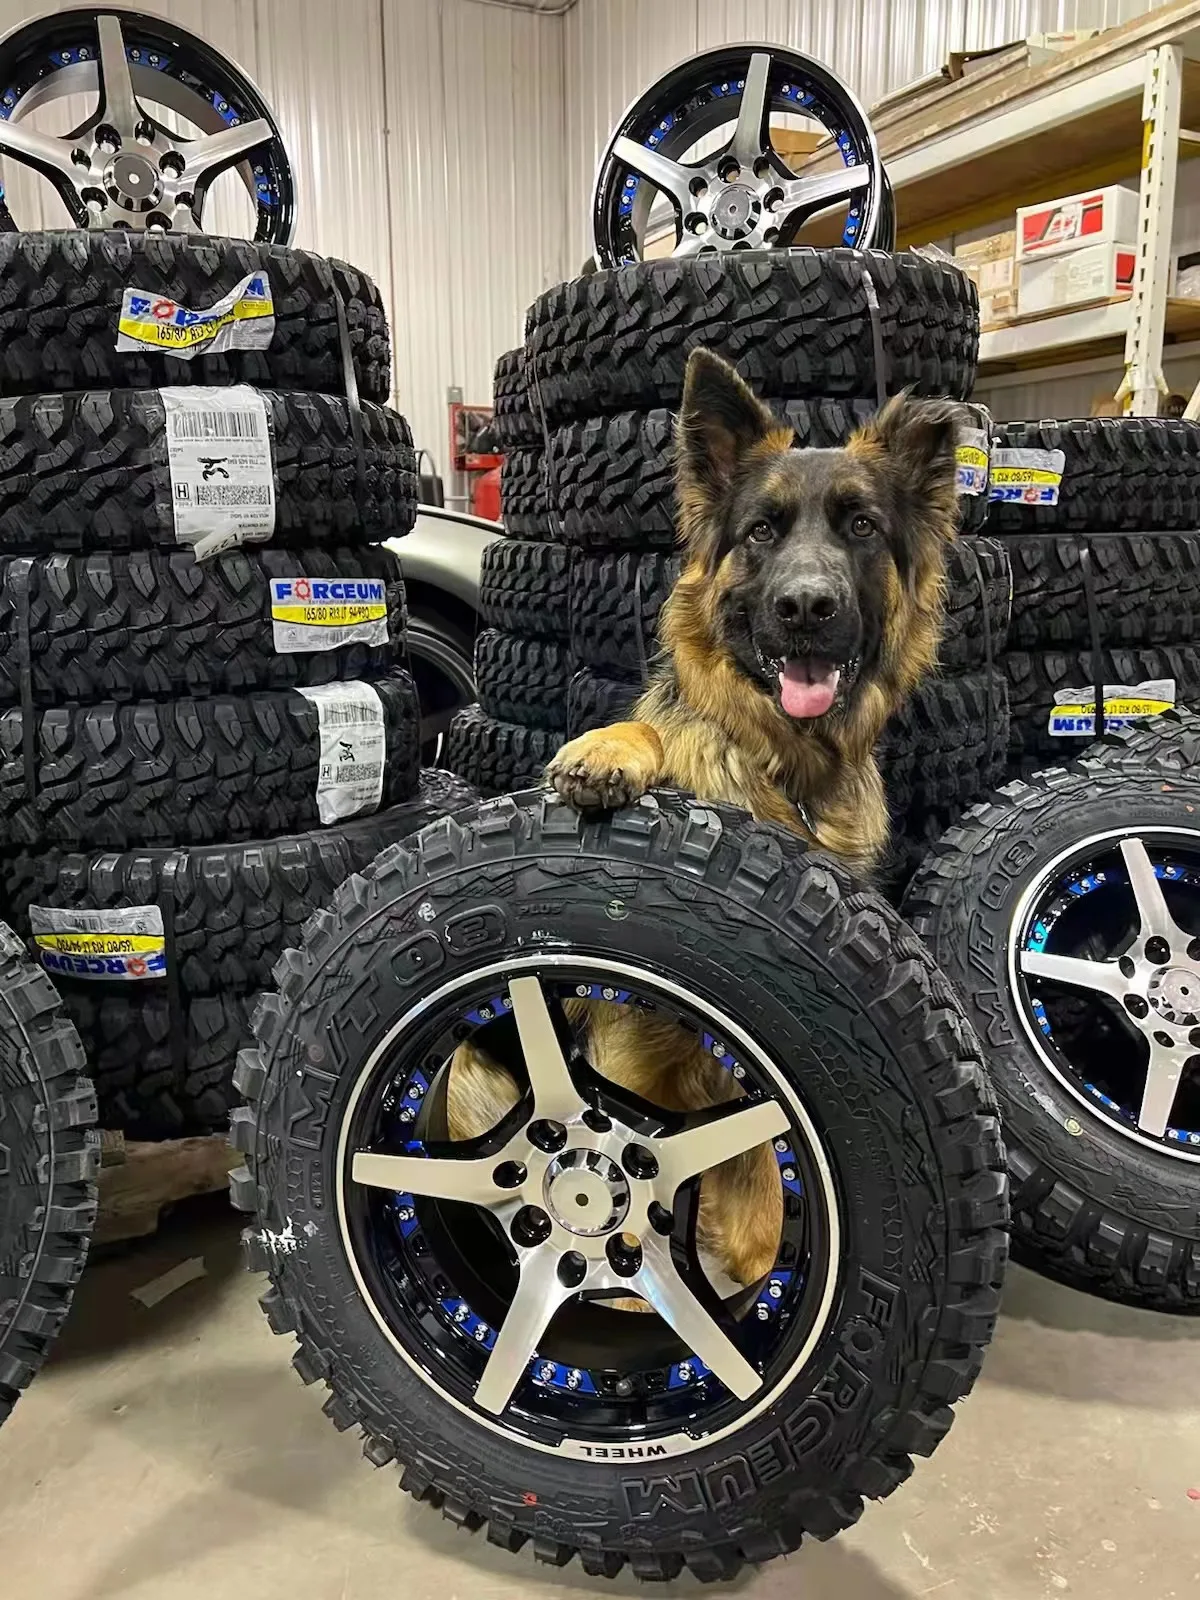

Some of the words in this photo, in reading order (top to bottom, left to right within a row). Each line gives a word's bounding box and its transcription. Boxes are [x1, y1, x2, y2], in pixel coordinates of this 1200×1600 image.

[1010, 471, 1034, 482] 165/80
[275, 579, 382, 600] FORCEUM
[303, 607, 327, 621] 165/80
[329, 606, 341, 619] R13
[92, 940, 105, 953] R13
[106, 939, 136, 952] 165/80
[43, 953, 167, 976] FORCEUM
[288, 969, 380, 1151] M/T
[621, 1265, 901, 1520] FORCEUM
[579, 1445, 667, 1458] WHEEL
